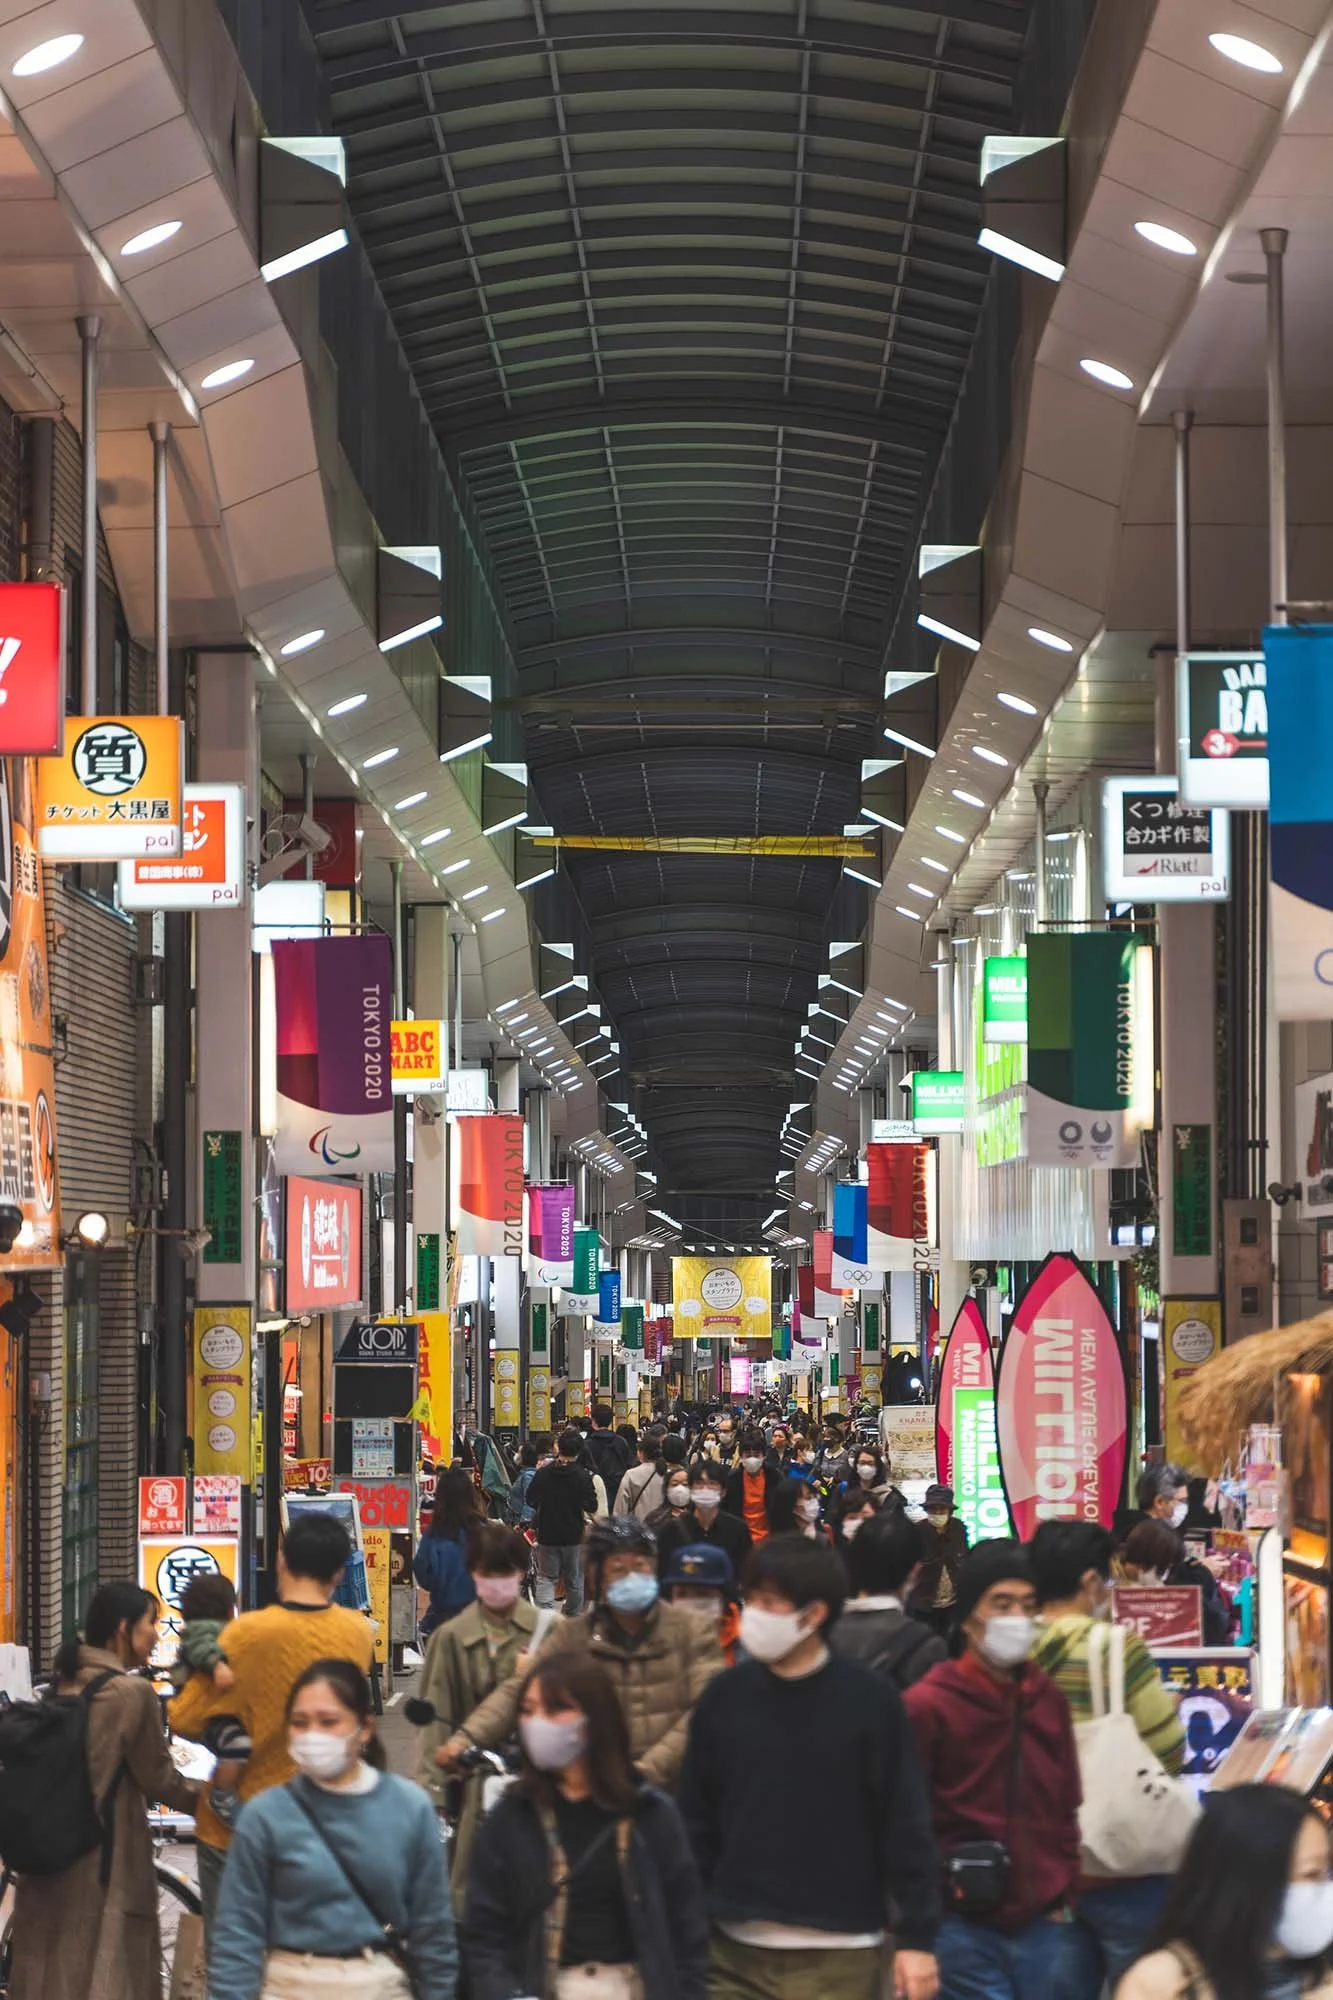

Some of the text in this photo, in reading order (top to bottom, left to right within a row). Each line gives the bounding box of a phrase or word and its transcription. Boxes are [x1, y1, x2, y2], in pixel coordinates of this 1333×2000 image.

[81, 734, 137, 787] 質
[47, 799, 171, 820] チケット 大黒屋
[145, 829, 174, 851] pal
[1126, 825, 1209, 844] 合カギ作製
[213, 884, 238, 903] pal
[1200, 876, 1226, 895] pal
[363, 984, 382, 1100] TOKYO 2020
[391, 1031, 434, 1054] ABC
[391, 1055, 434, 1070] MART
[1116, 1047, 1135, 1096] 2020
[430, 1080, 446, 1090] pal
[917, 1085, 964, 1099] MILLIO
[503, 1200, 523, 1257] 2020
[561, 1206, 571, 1257] TOKYO 2020
[588, 1247, 597, 1290] TOKYO 2020
[611, 1285, 620, 1305] TOKYO
[360, 1502, 408, 1527] OM
